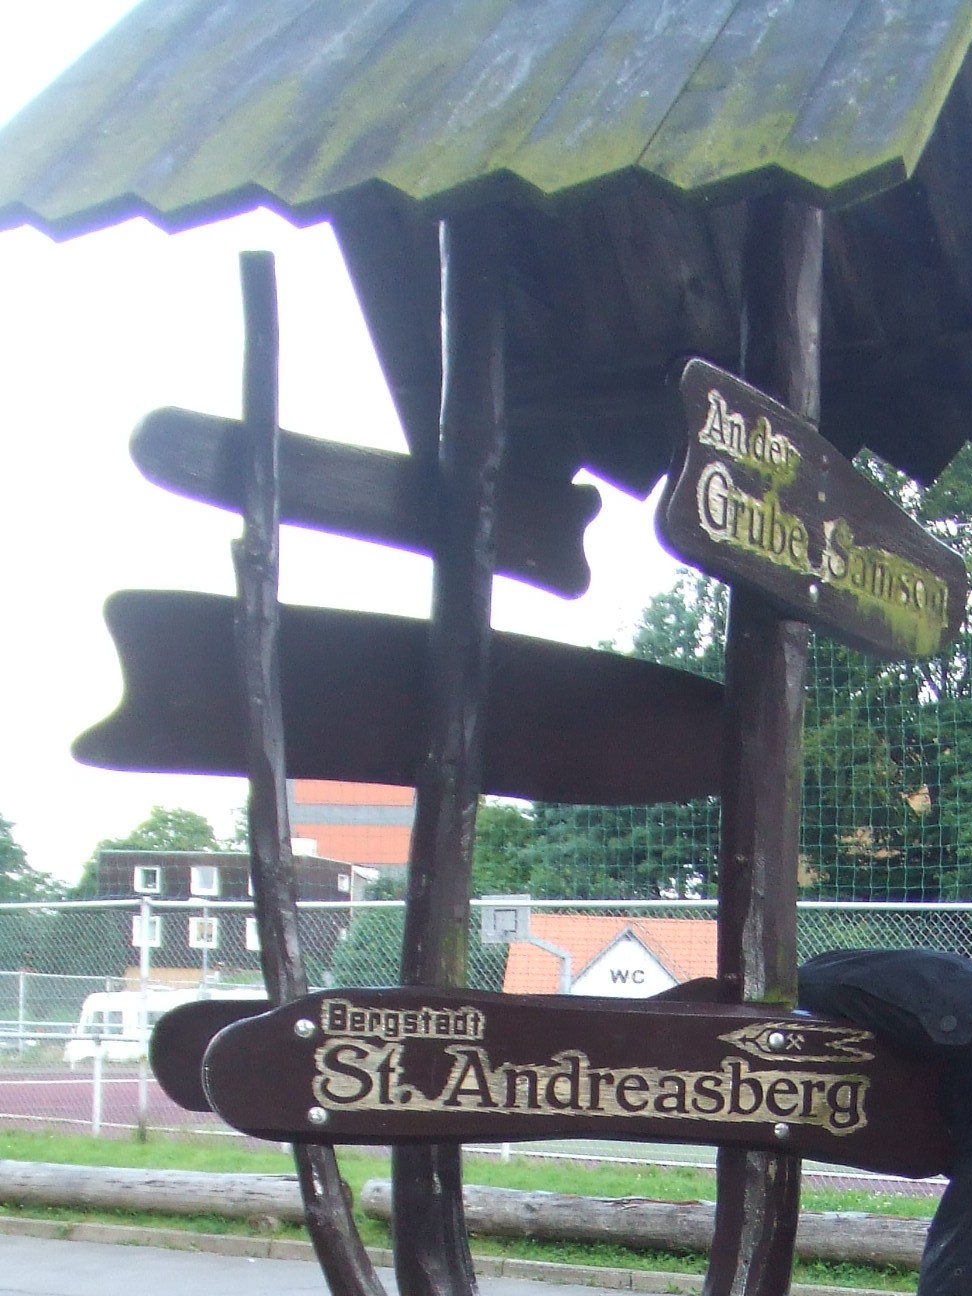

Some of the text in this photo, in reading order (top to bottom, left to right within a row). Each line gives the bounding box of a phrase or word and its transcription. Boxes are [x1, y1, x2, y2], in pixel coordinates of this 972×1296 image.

[700, 394, 798, 467] An der
[702, 470, 945, 622] Grube Samson
[609, 968, 645, 984] WC
[328, 1002, 483, 1038] Bergstadt
[319, 1043, 864, 1130] St. Andreasberg
